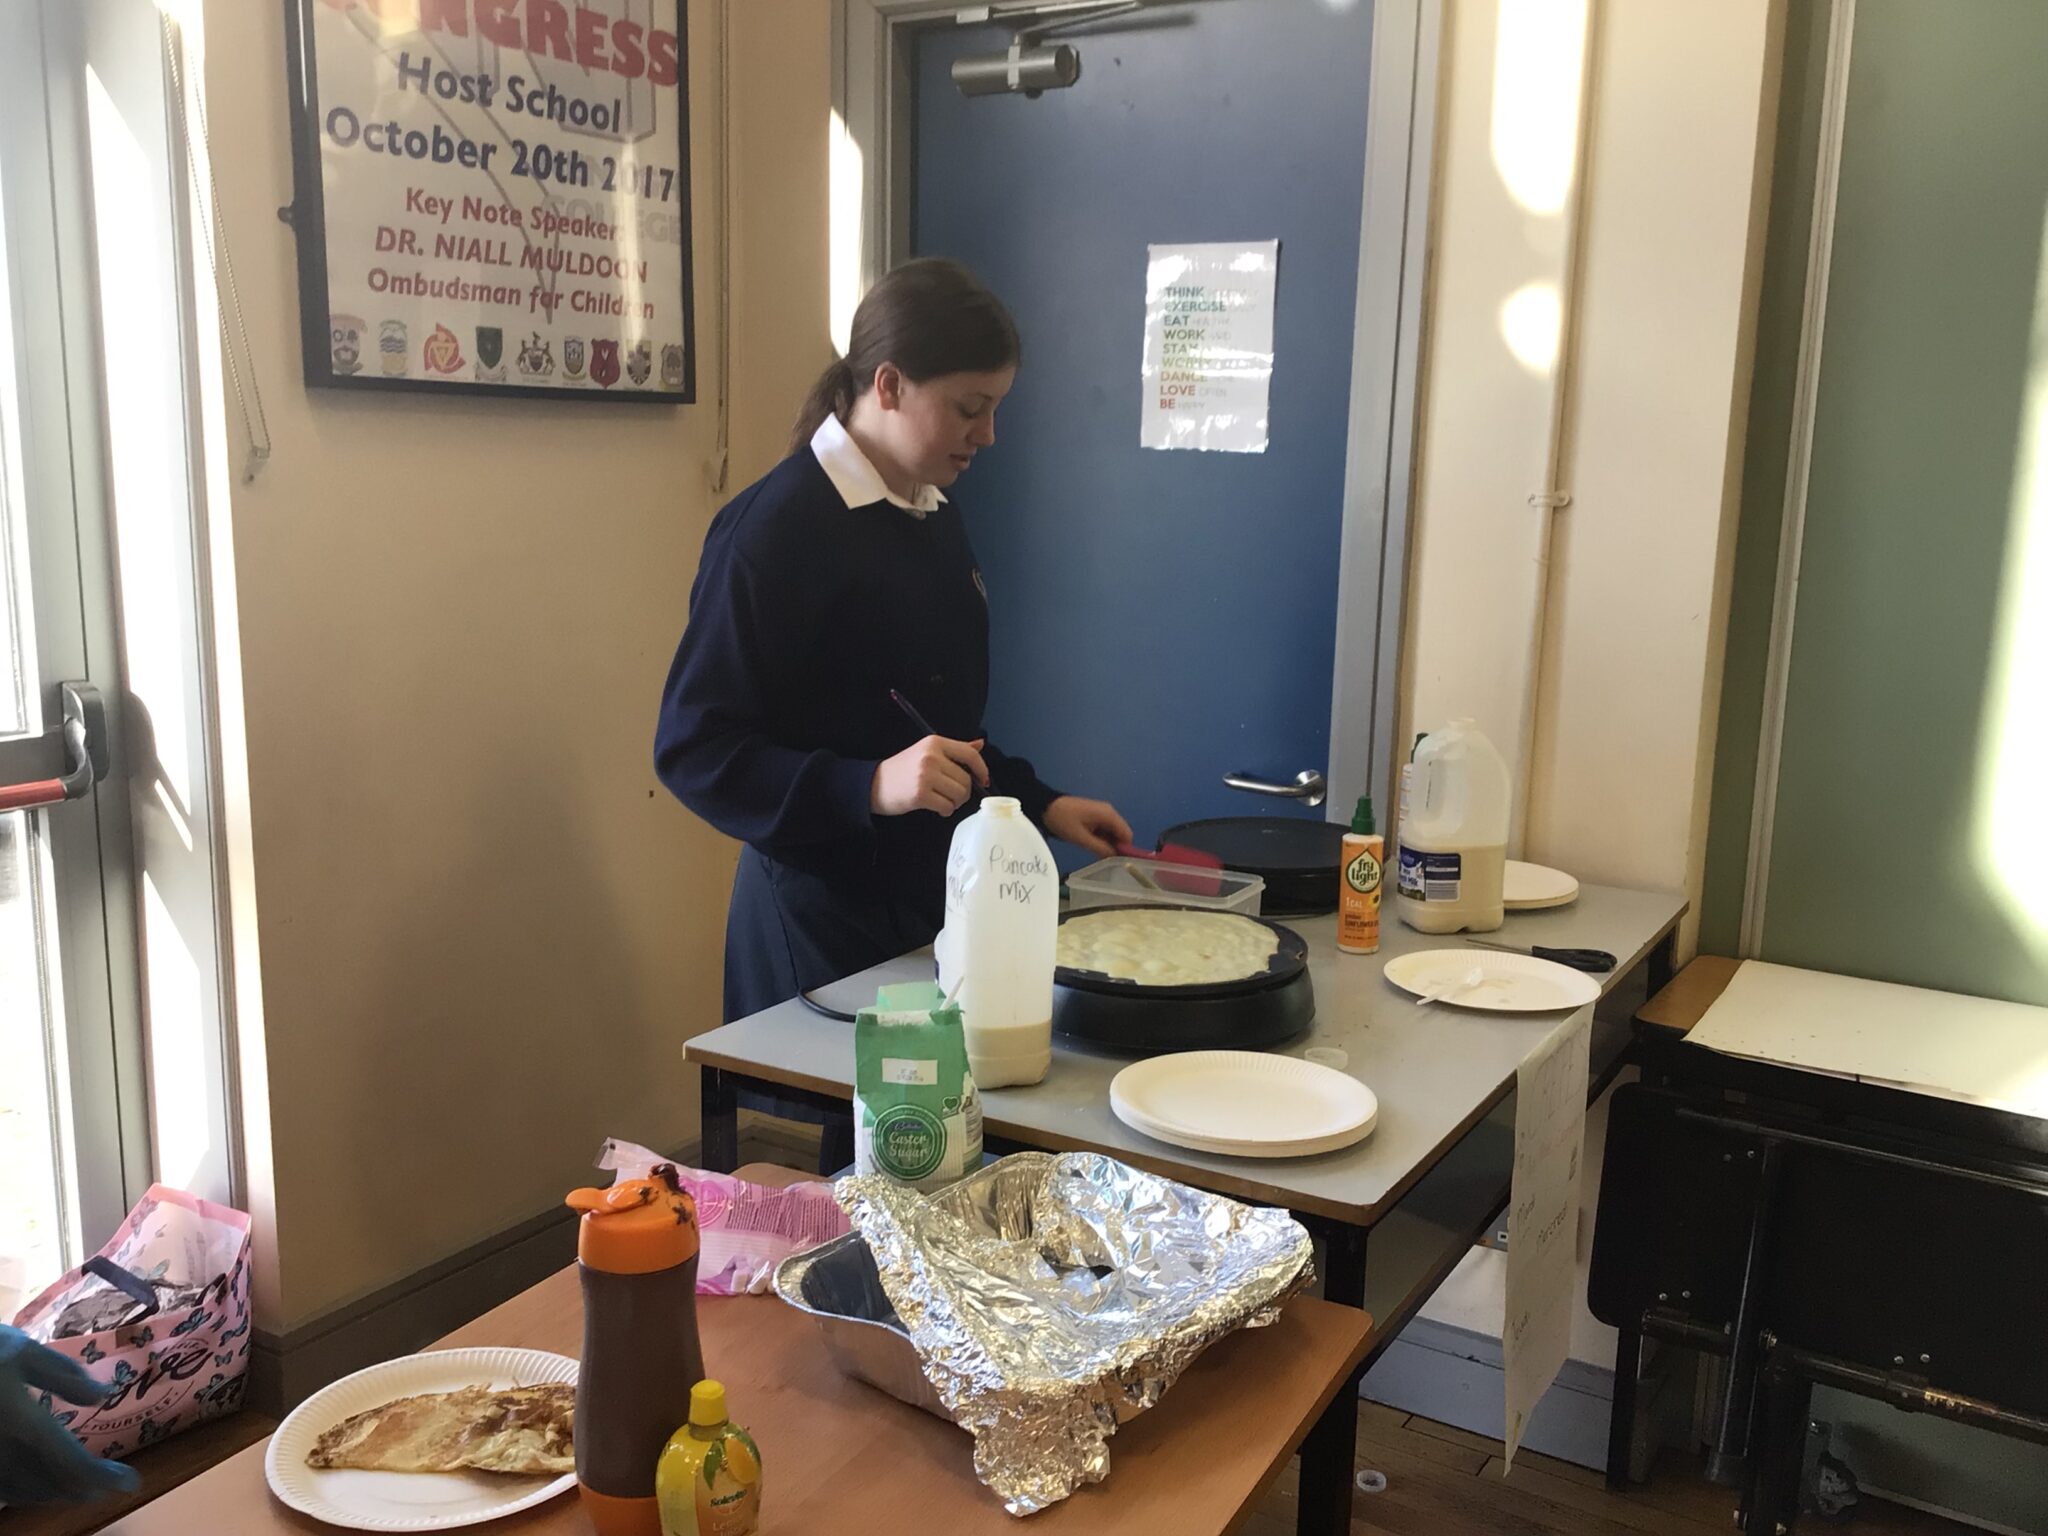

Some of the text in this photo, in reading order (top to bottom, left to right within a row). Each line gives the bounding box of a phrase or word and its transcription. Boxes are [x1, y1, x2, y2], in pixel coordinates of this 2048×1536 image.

[322, 0, 679, 88] NGRESS
[398, 51, 621, 133] Host School
[326, 106, 498, 170] October
[510, 139, 588, 187] 20th
[406, 187, 454, 224] Key
[462, 195, 523, 227] Note
[375, 226, 424, 257] DR.
[434, 233, 512, 267] NIALL
[367, 268, 655, 320] Ombudsman for Childn
[1165, 286, 1204, 297] THINK
[1165, 301, 1226, 312] EXERCISE
[1164, 314, 1190, 326] EAT
[1163, 329, 1205, 340] WORK
[1160, 384, 1195, 396] LOVE
[1159, 398, 1175, 409] BE
[989, 844, 1048, 876] Pancake
[1357, 859, 1374, 874] fry
[1352, 869, 1378, 886] light
[889, 1132, 928, 1145] Caster
[889, 1144, 928, 1161] Sugar
[91, 1398, 171, 1431] YOURSELF
